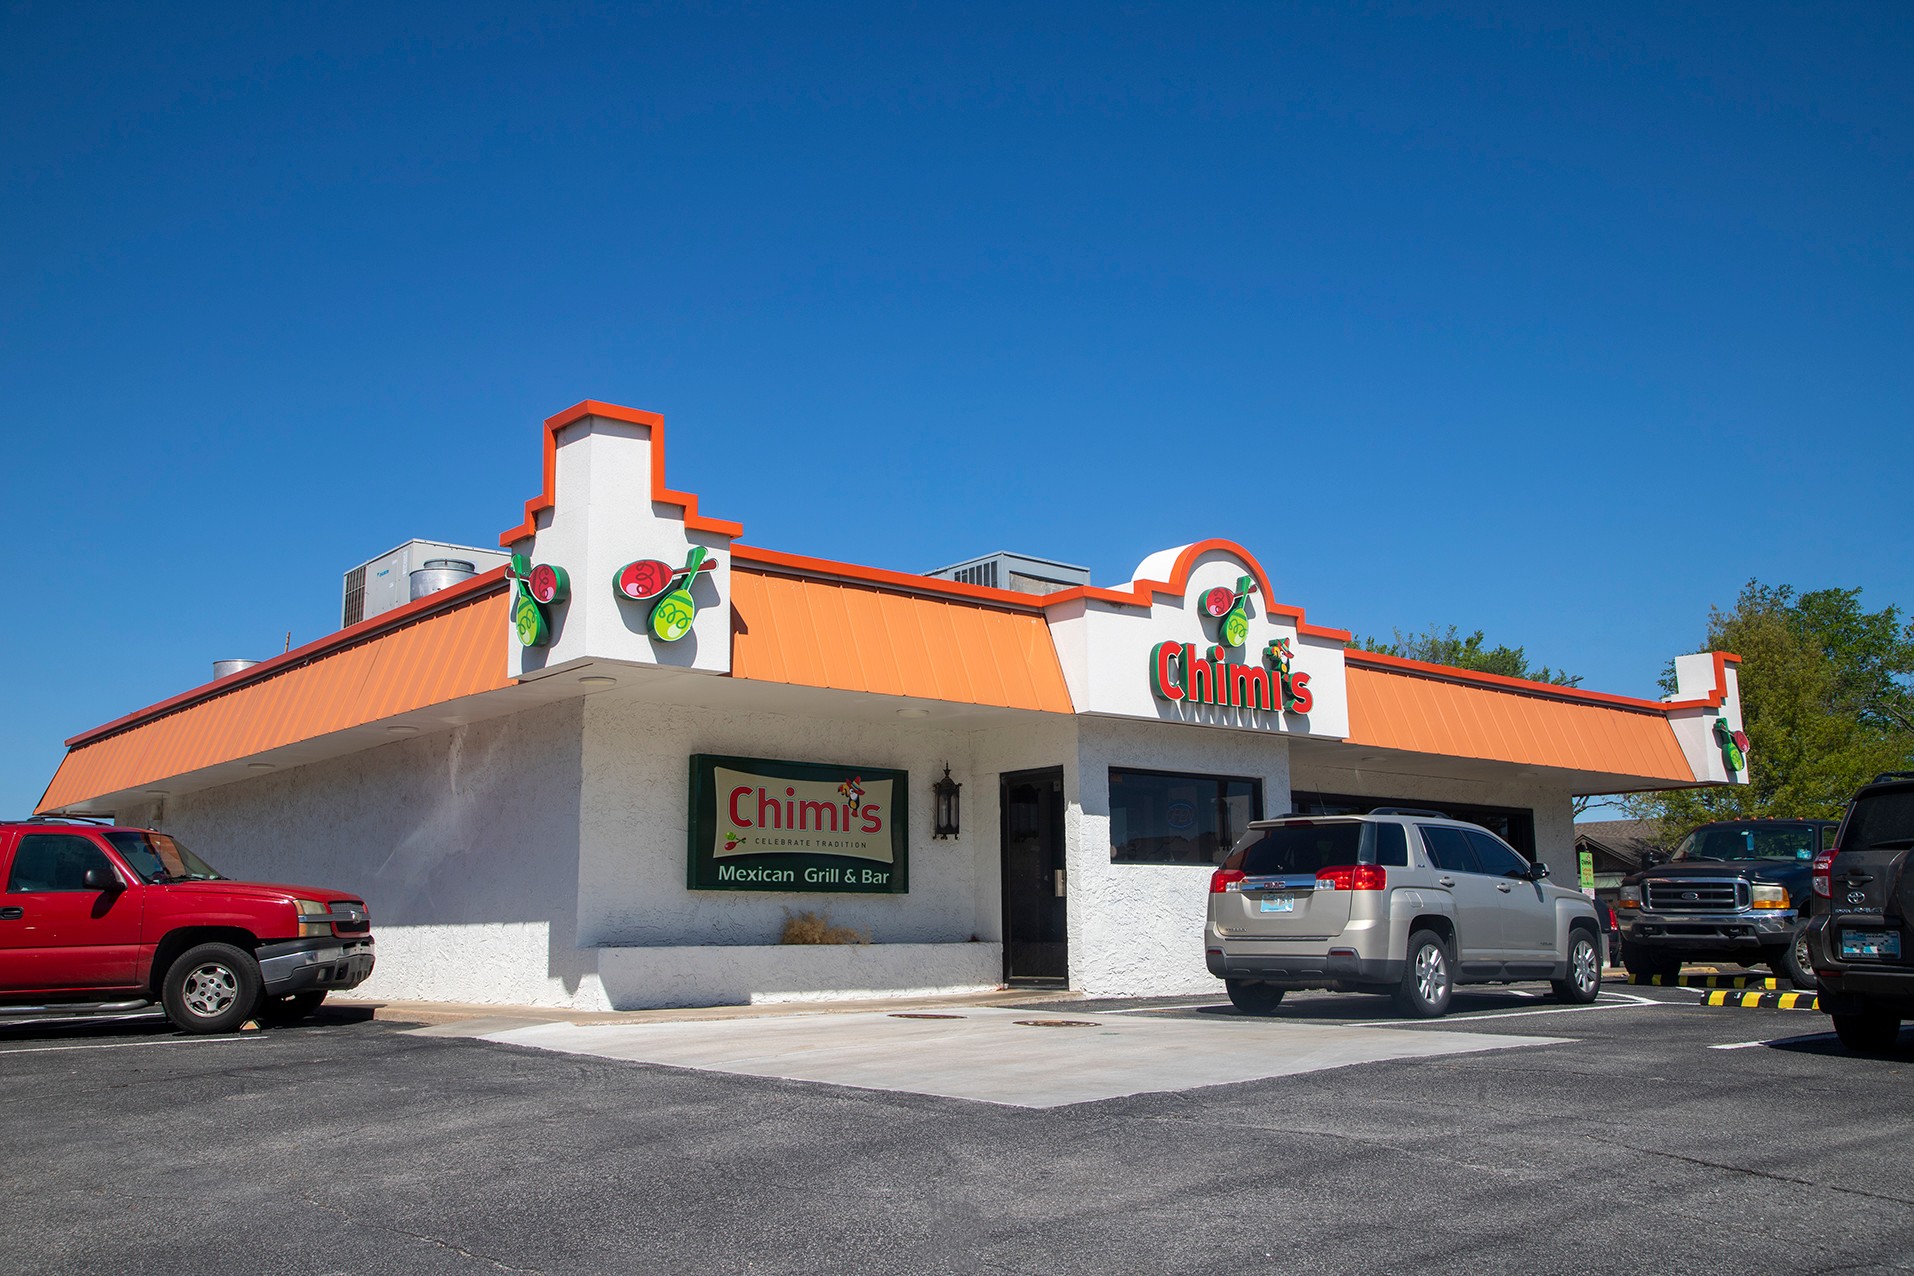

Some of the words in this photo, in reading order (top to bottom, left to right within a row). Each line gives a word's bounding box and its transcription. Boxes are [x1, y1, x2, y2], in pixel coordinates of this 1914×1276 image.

[755, 837, 811, 847] CELEBRATE
[816, 840, 867, 849] TRADITION
[718, 865, 794, 882] Mexican
[804, 867, 839, 883] Grill
[844, 869, 856, 883] &
[862, 869, 889, 884] Bar
